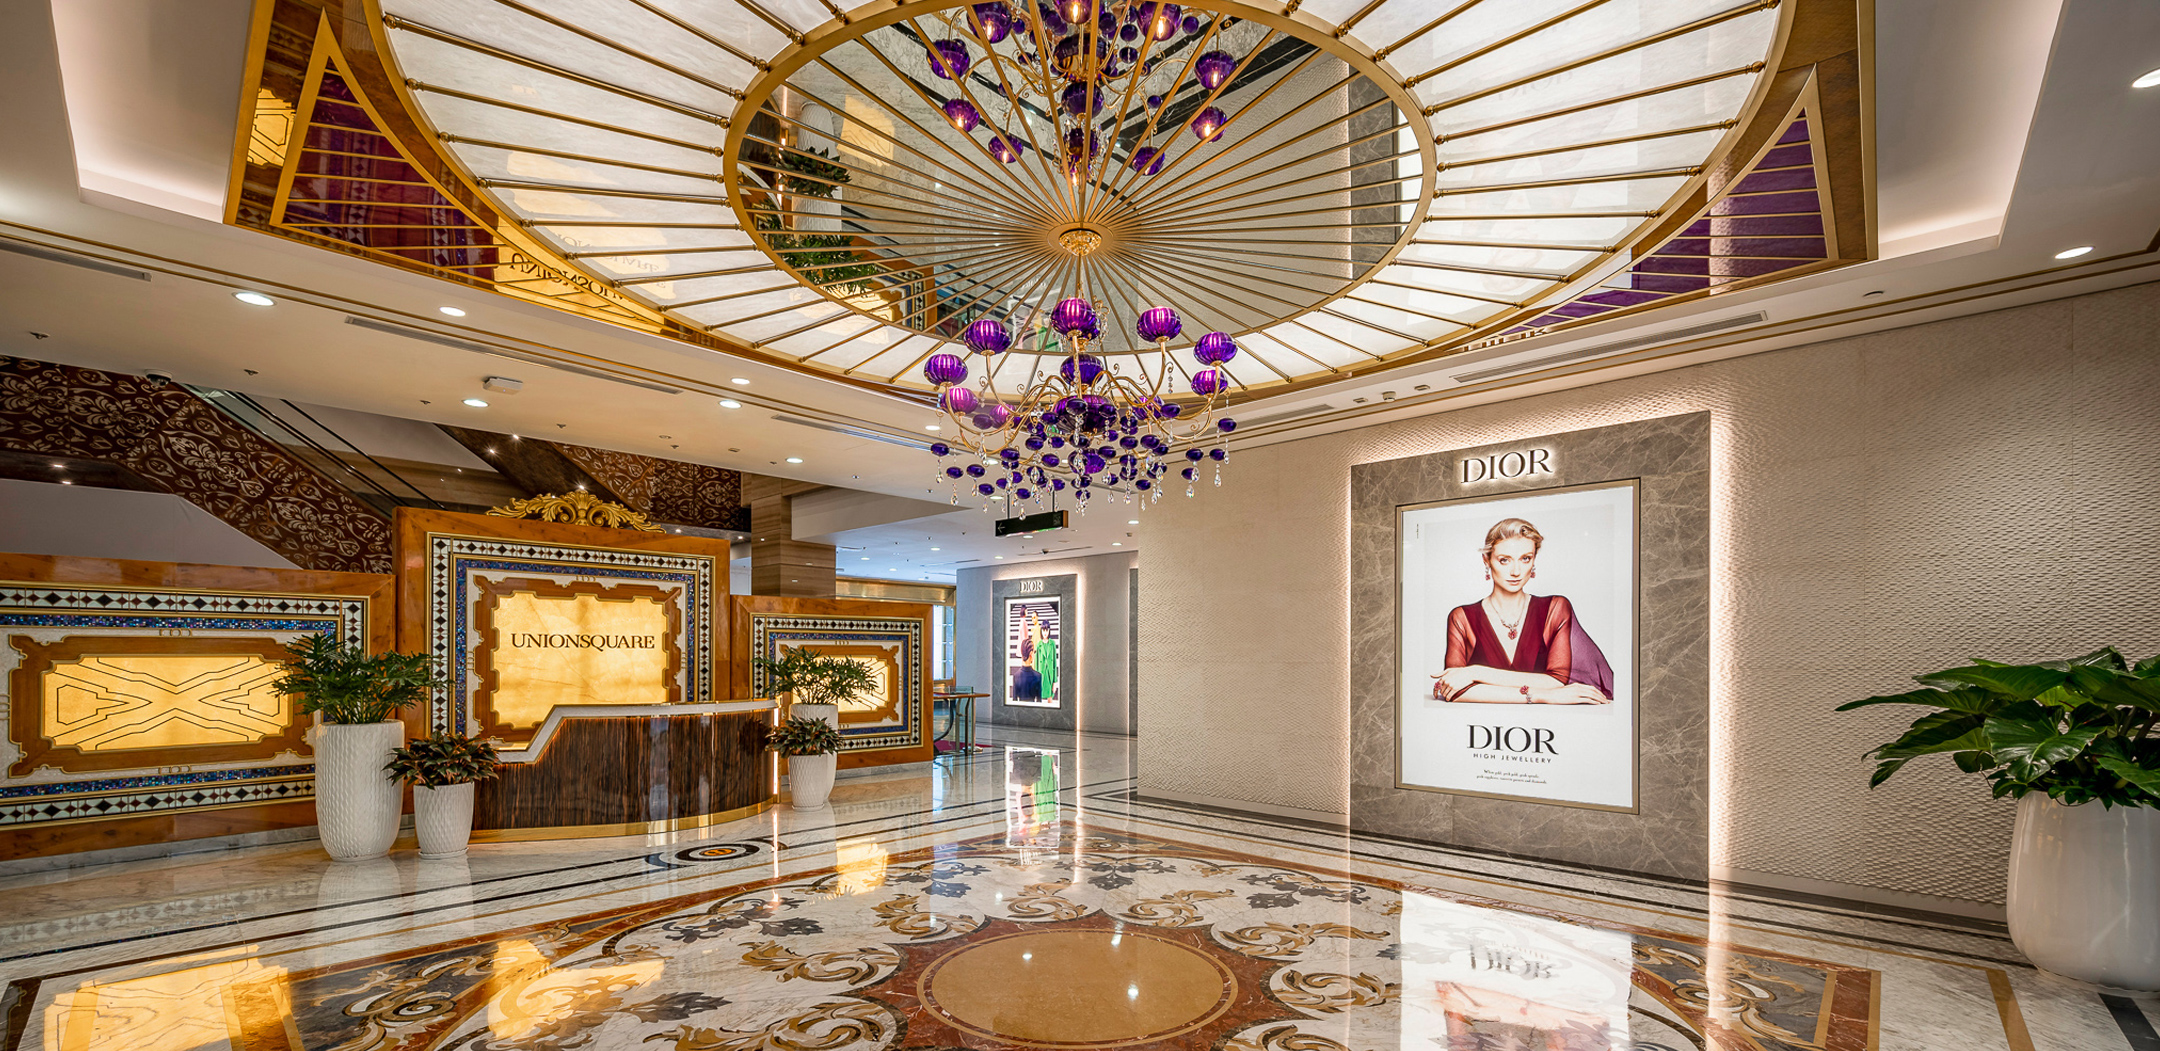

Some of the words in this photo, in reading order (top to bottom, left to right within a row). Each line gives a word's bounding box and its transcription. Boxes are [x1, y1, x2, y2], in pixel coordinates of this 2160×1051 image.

[1461, 448, 1553, 484] DIOR
[1019, 580, 1042, 592] DIOR
[511, 633, 655, 652] UNIONSQUARE
[1467, 724, 1559, 755] DIOR
[1501, 755, 1552, 764] JEWELLERY
